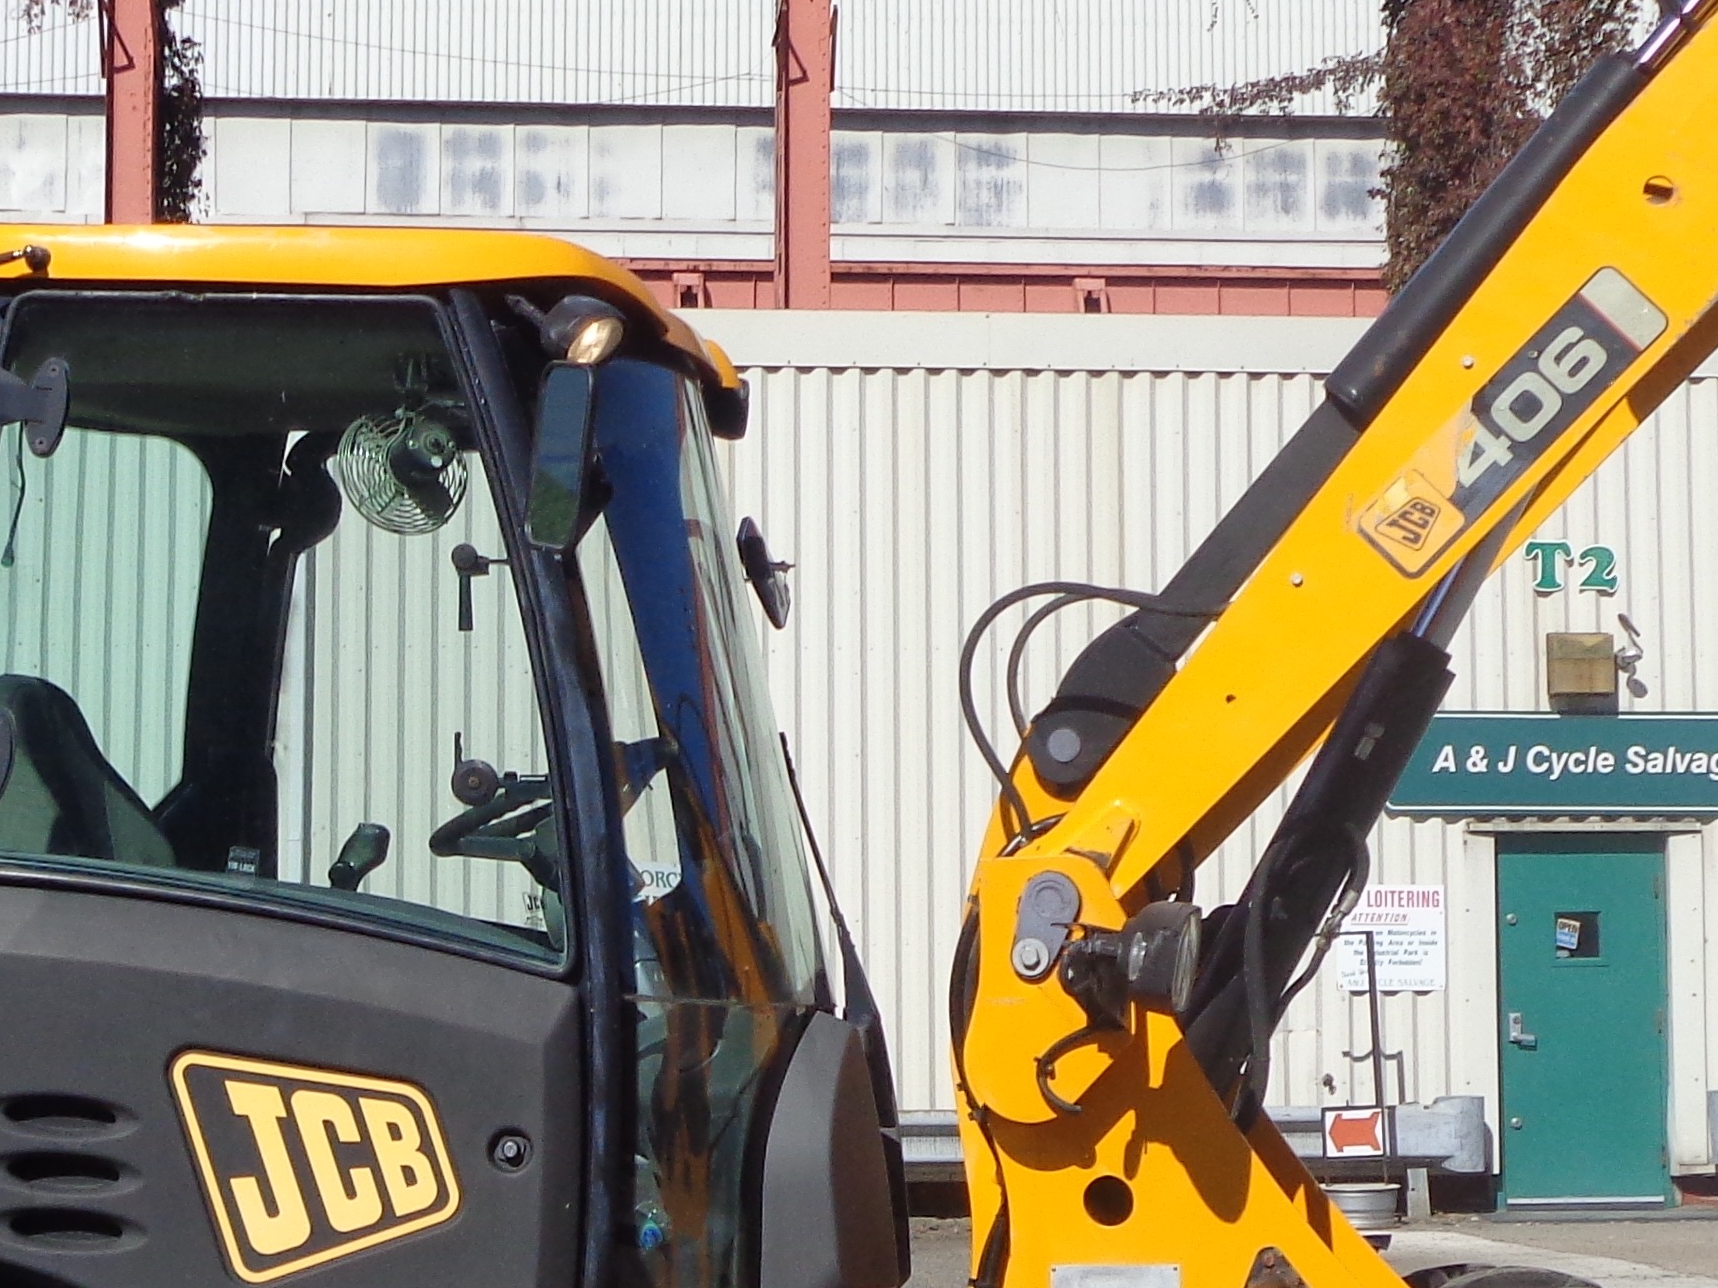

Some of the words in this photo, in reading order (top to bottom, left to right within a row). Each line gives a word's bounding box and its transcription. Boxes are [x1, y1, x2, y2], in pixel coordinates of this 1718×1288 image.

[1457, 326, 1608, 488] 406
[1385, 501, 1436, 545] JCB
[1523, 539, 1619, 594] T2
[1432, 745, 1457, 773] A
[1466, 745, 1489, 773] &
[1497, 745, 1517, 773] J
[1526, 745, 1615, 780] Cycle
[1351, 912, 1408, 922] ATTENTION
[1366, 890, 1440, 908] LOITERING
[224, 1079, 438, 1255] JCB
